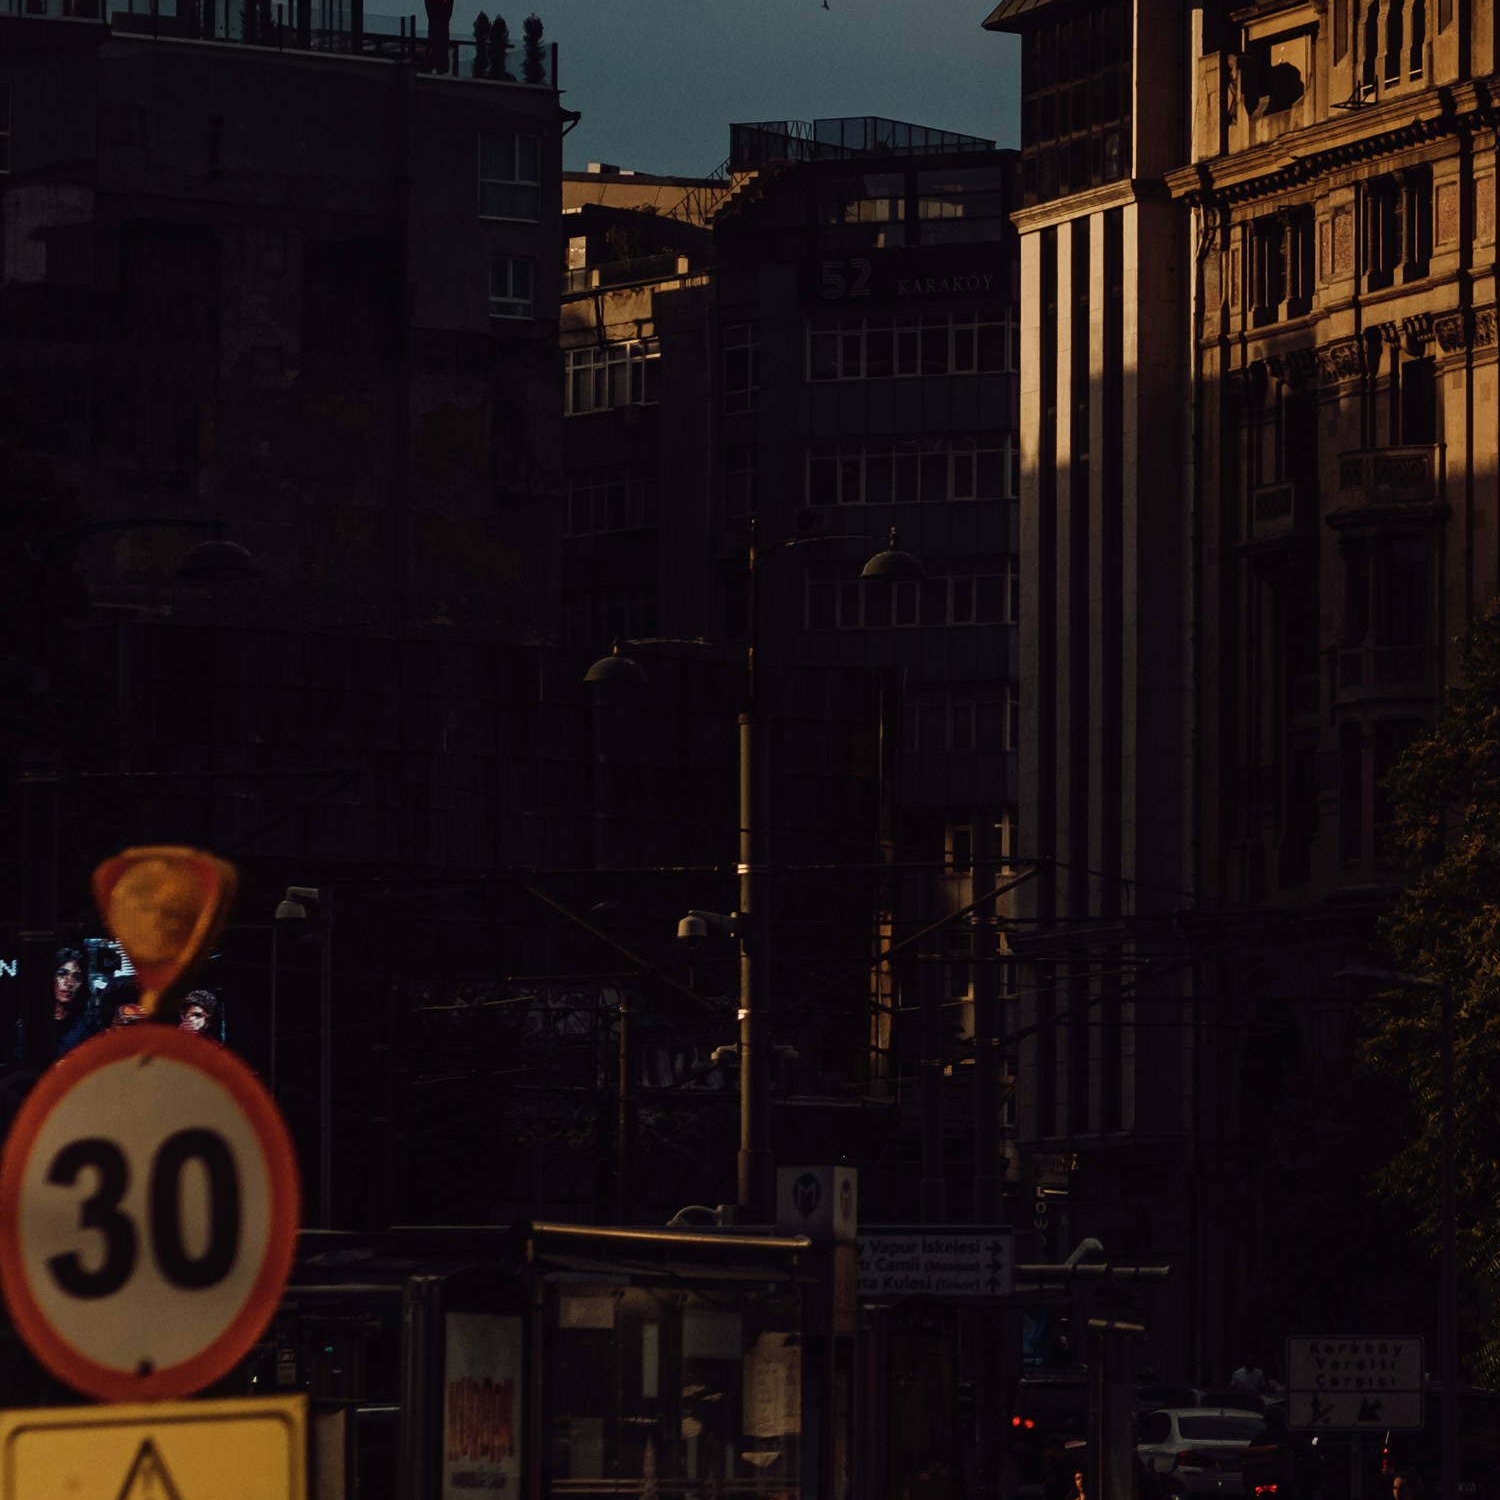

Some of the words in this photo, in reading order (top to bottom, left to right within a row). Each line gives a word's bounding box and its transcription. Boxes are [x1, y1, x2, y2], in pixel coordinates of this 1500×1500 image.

[821, 258, 872, 299] 52
[898, 271, 994, 295] KARAKÖY
[48, 1126, 239, 1299] 30
[870, 1239, 917, 1257] Vapur
[922, 1237, 980, 1254] İskelesi
[876, 1257, 920, 1273] Camii
[924, 1261, 980, 1274] (Mosque)
[884, 1275, 931, 1290] Kulesi
[935, 1278, 980, 1292] (Tower)
[1310, 1340, 1402, 1357] Karaköy
